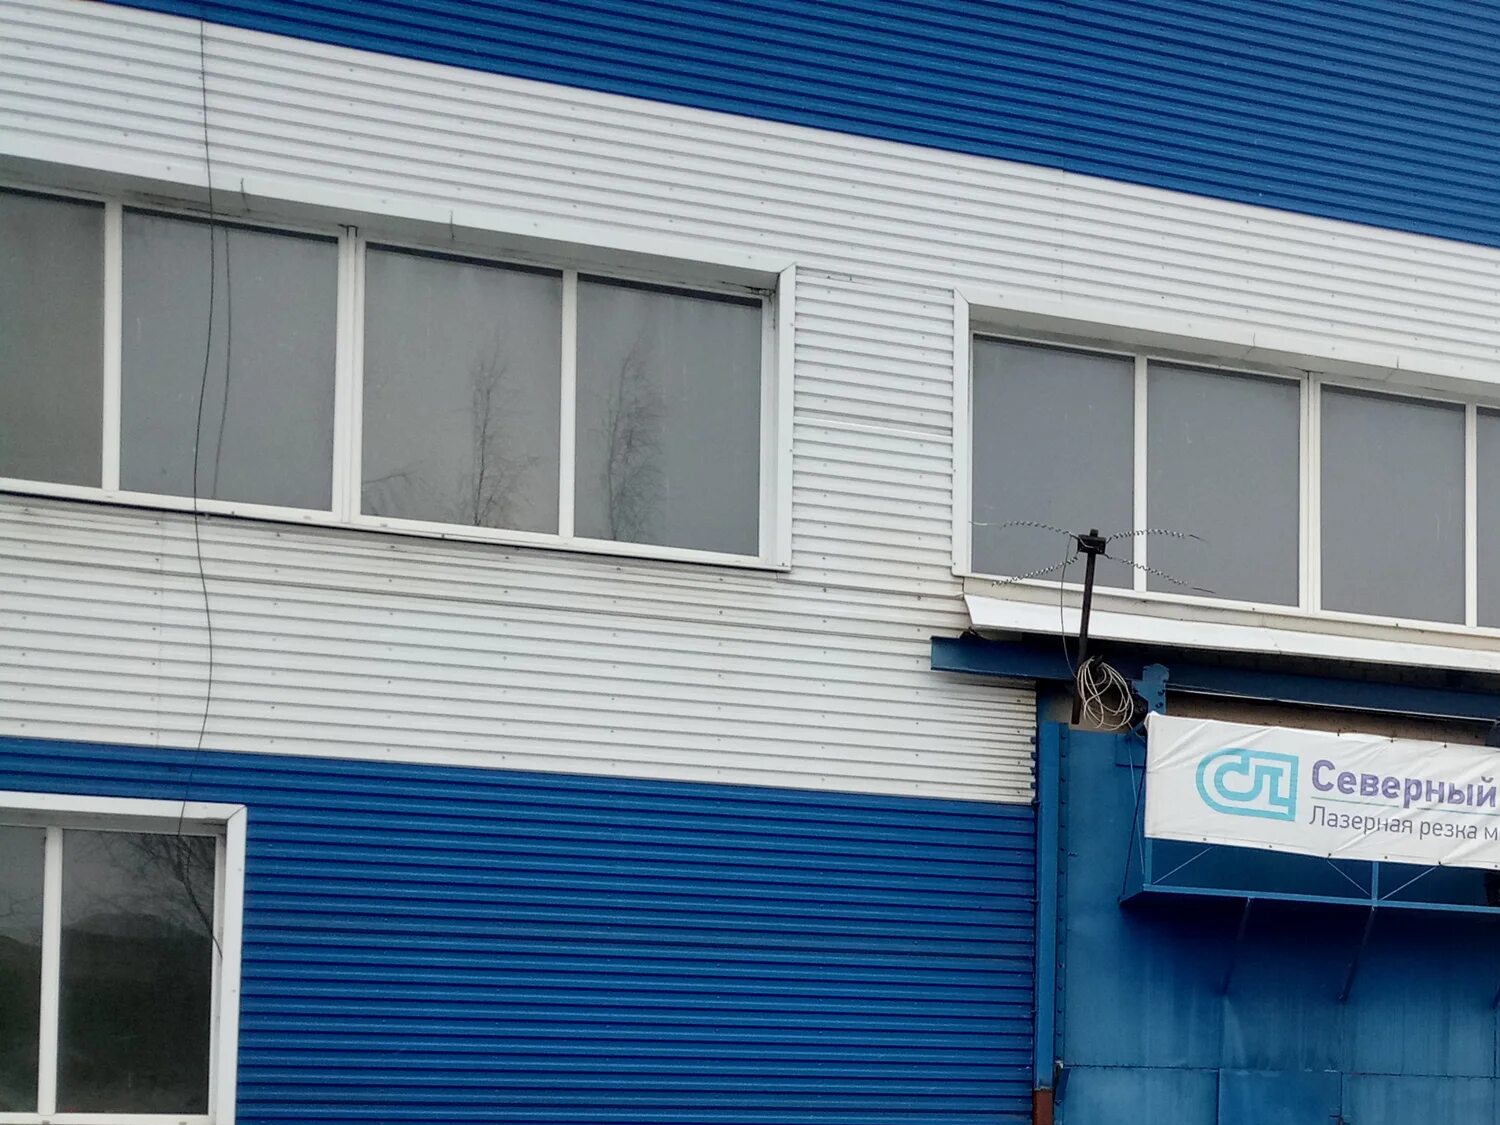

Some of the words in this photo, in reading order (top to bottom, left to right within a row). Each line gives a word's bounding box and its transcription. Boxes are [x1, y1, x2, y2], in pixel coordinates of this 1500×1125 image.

[1312, 759, 1496, 808] Северный
[1309, 805, 1413, 834] Лазерная
[1419, 821, 1477, 840] резка
